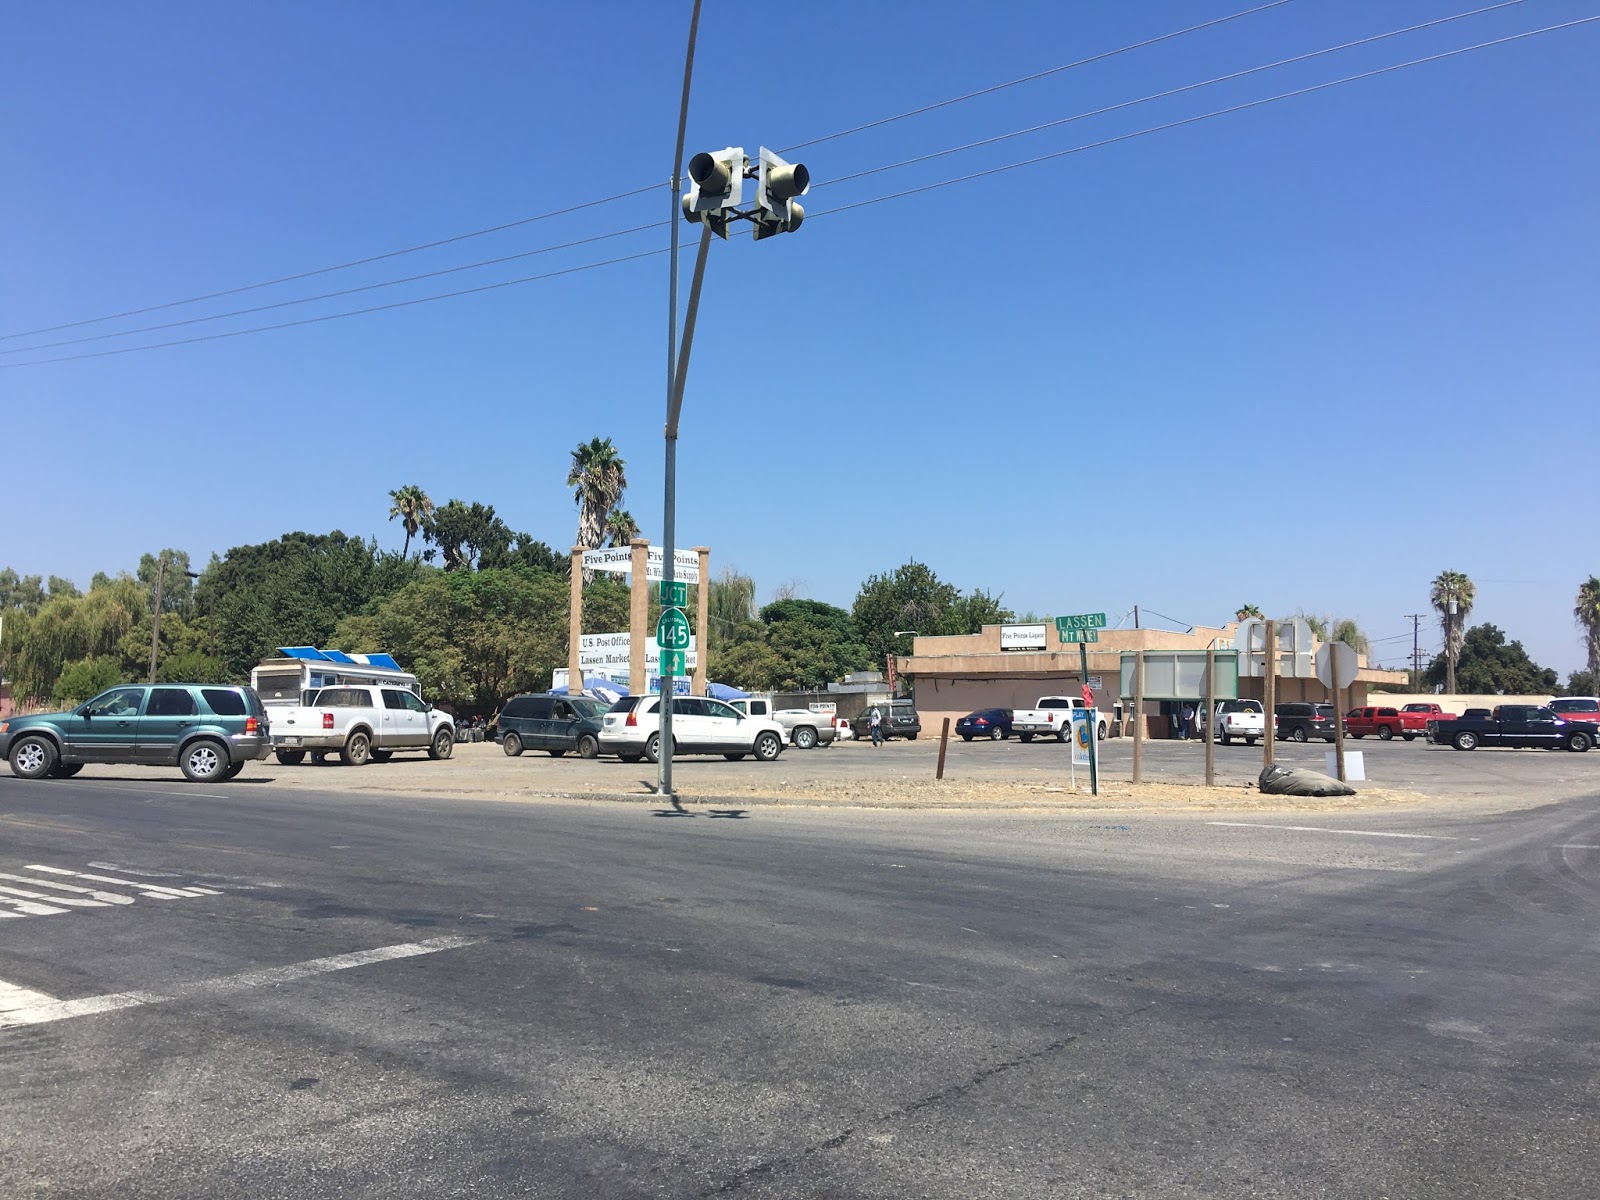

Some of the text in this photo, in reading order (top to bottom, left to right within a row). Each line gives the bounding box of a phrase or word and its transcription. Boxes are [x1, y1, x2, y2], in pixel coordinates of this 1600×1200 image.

[583, 552, 632, 564] Five Points
[647, 552, 664, 560] Fiv
[661, 586, 686, 602] JCT
[1059, 614, 1102, 630] LASSEN
[661, 625, 687, 644] 145
[1062, 630, 1096, 642] MT WHNEY
[582, 636, 630, 648] U.S. Post Office
[581, 654, 630, 664] Lassen Market
